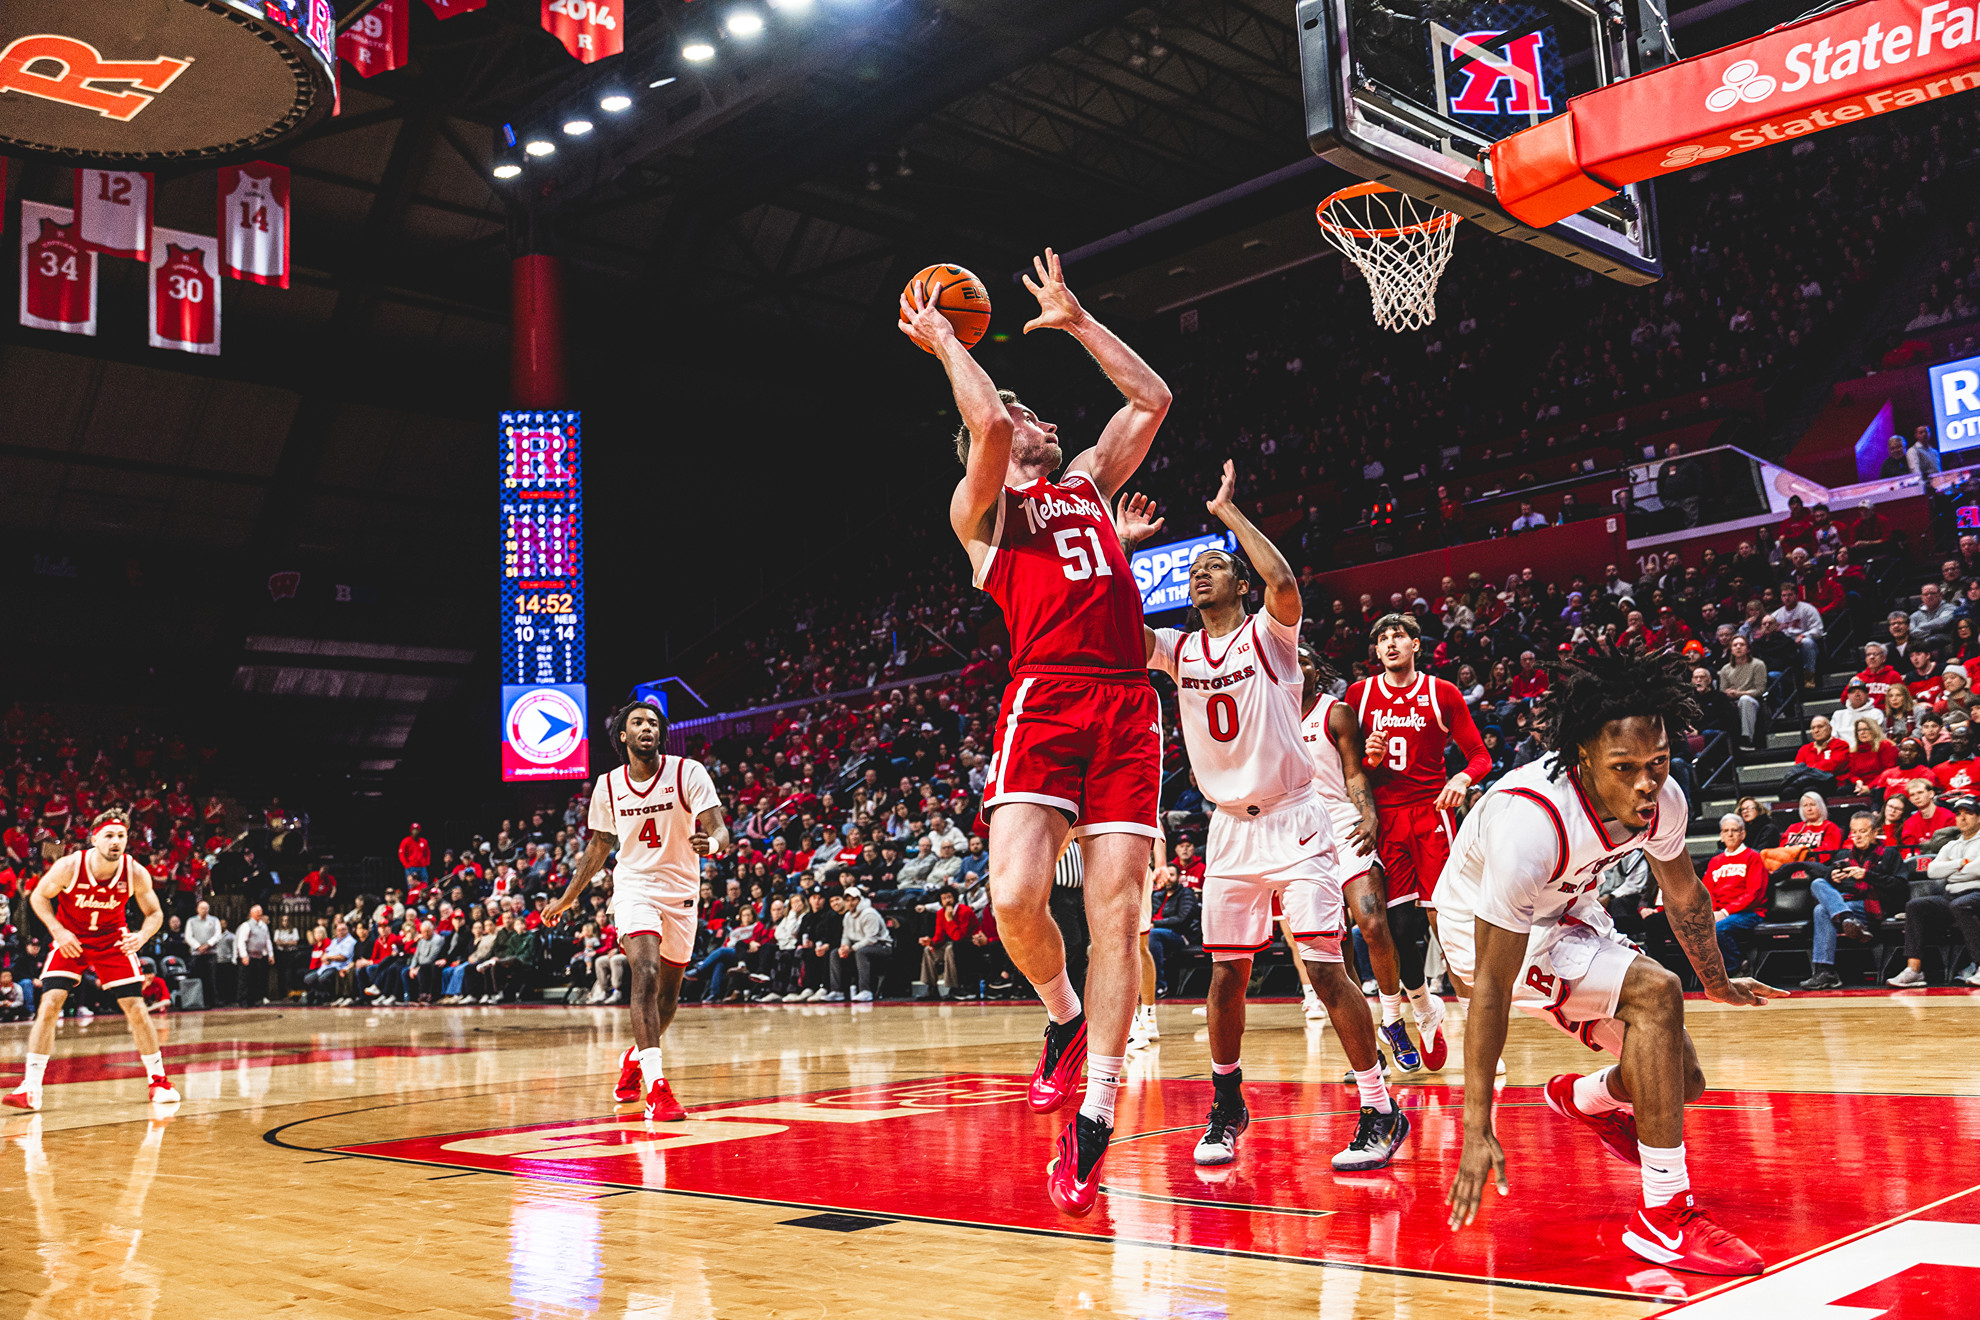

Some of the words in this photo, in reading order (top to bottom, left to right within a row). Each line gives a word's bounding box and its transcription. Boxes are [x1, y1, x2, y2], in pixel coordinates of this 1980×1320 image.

[549, 0, 616, 30] 2014
[578, 34, 592, 50] R
[1781, 22, 1912, 93] State
[1916, 1, 1980, 57] Fa
[358, 46, 372, 64] R
[0, 34, 191, 122] R
[1730, 103, 1865, 149] State
[98, 172, 132, 206] 12
[240, 201, 268, 233] 14
[40, 252, 78, 282] 34
[168, 275, 204, 303] 30
[517, 413, 530, 423] PT
[536, 413, 544, 423] R
[551, 413, 560, 423] A
[1946, 416, 1980, 440] OT
[538, 426, 545, 436] 1
[553, 426, 560, 436] 0
[507, 439, 514, 449] 1
[522, 439, 530, 449] 0
[539, 439, 545, 449] 1
[553, 439, 560, 449] 0
[522, 452, 530, 462] 0
[537, 452, 545, 462] 0
[553, 452, 561, 462] 0
[522, 478, 530, 488] 0
[538, 478, 545, 488] 0
[555, 478, 561, 488] 1
[519, 504, 532, 513] PT
[538, 504, 546, 513] R
[553, 504, 562, 513] A
[569, 504, 576, 513] F
[1018, 492, 1103, 534] Nebraska
[508, 514, 515, 525] 1
[522, 514, 530, 525] 4
[538, 514, 545, 525] 0
[553, 514, 561, 525] 0
[522, 527, 530, 538] 0
[538, 527, 546, 538] 2
[553, 527, 561, 538] 0
[522, 540, 530, 551] 2
[539, 540, 546, 551] 1
[554, 540, 562, 551] 3
[1053, 527, 1112, 581] 51
[522, 553, 531, 564] 3
[538, 553, 546, 564] 2
[554, 553, 562, 564] 0
[540, 566, 546, 577] 1
[554, 566, 562, 577] 0
[515, 593, 573, 614] 14:52
[515, 615, 532, 625] RU
[554, 614, 577, 624] NEB
[514, 626, 534, 642] 10
[555, 625, 575, 641] 14
[1182, 665, 1256, 690] RUTGERS
[1206, 693, 1240, 742] 0
[1370, 706, 1427, 732] Nebraska
[1388, 736, 1407, 771] 9
[620, 802, 674, 816] RUTGERS
[638, 818, 662, 848] 4
[88, 911, 100, 931] 1
[1526, 964, 1556, 998] R
